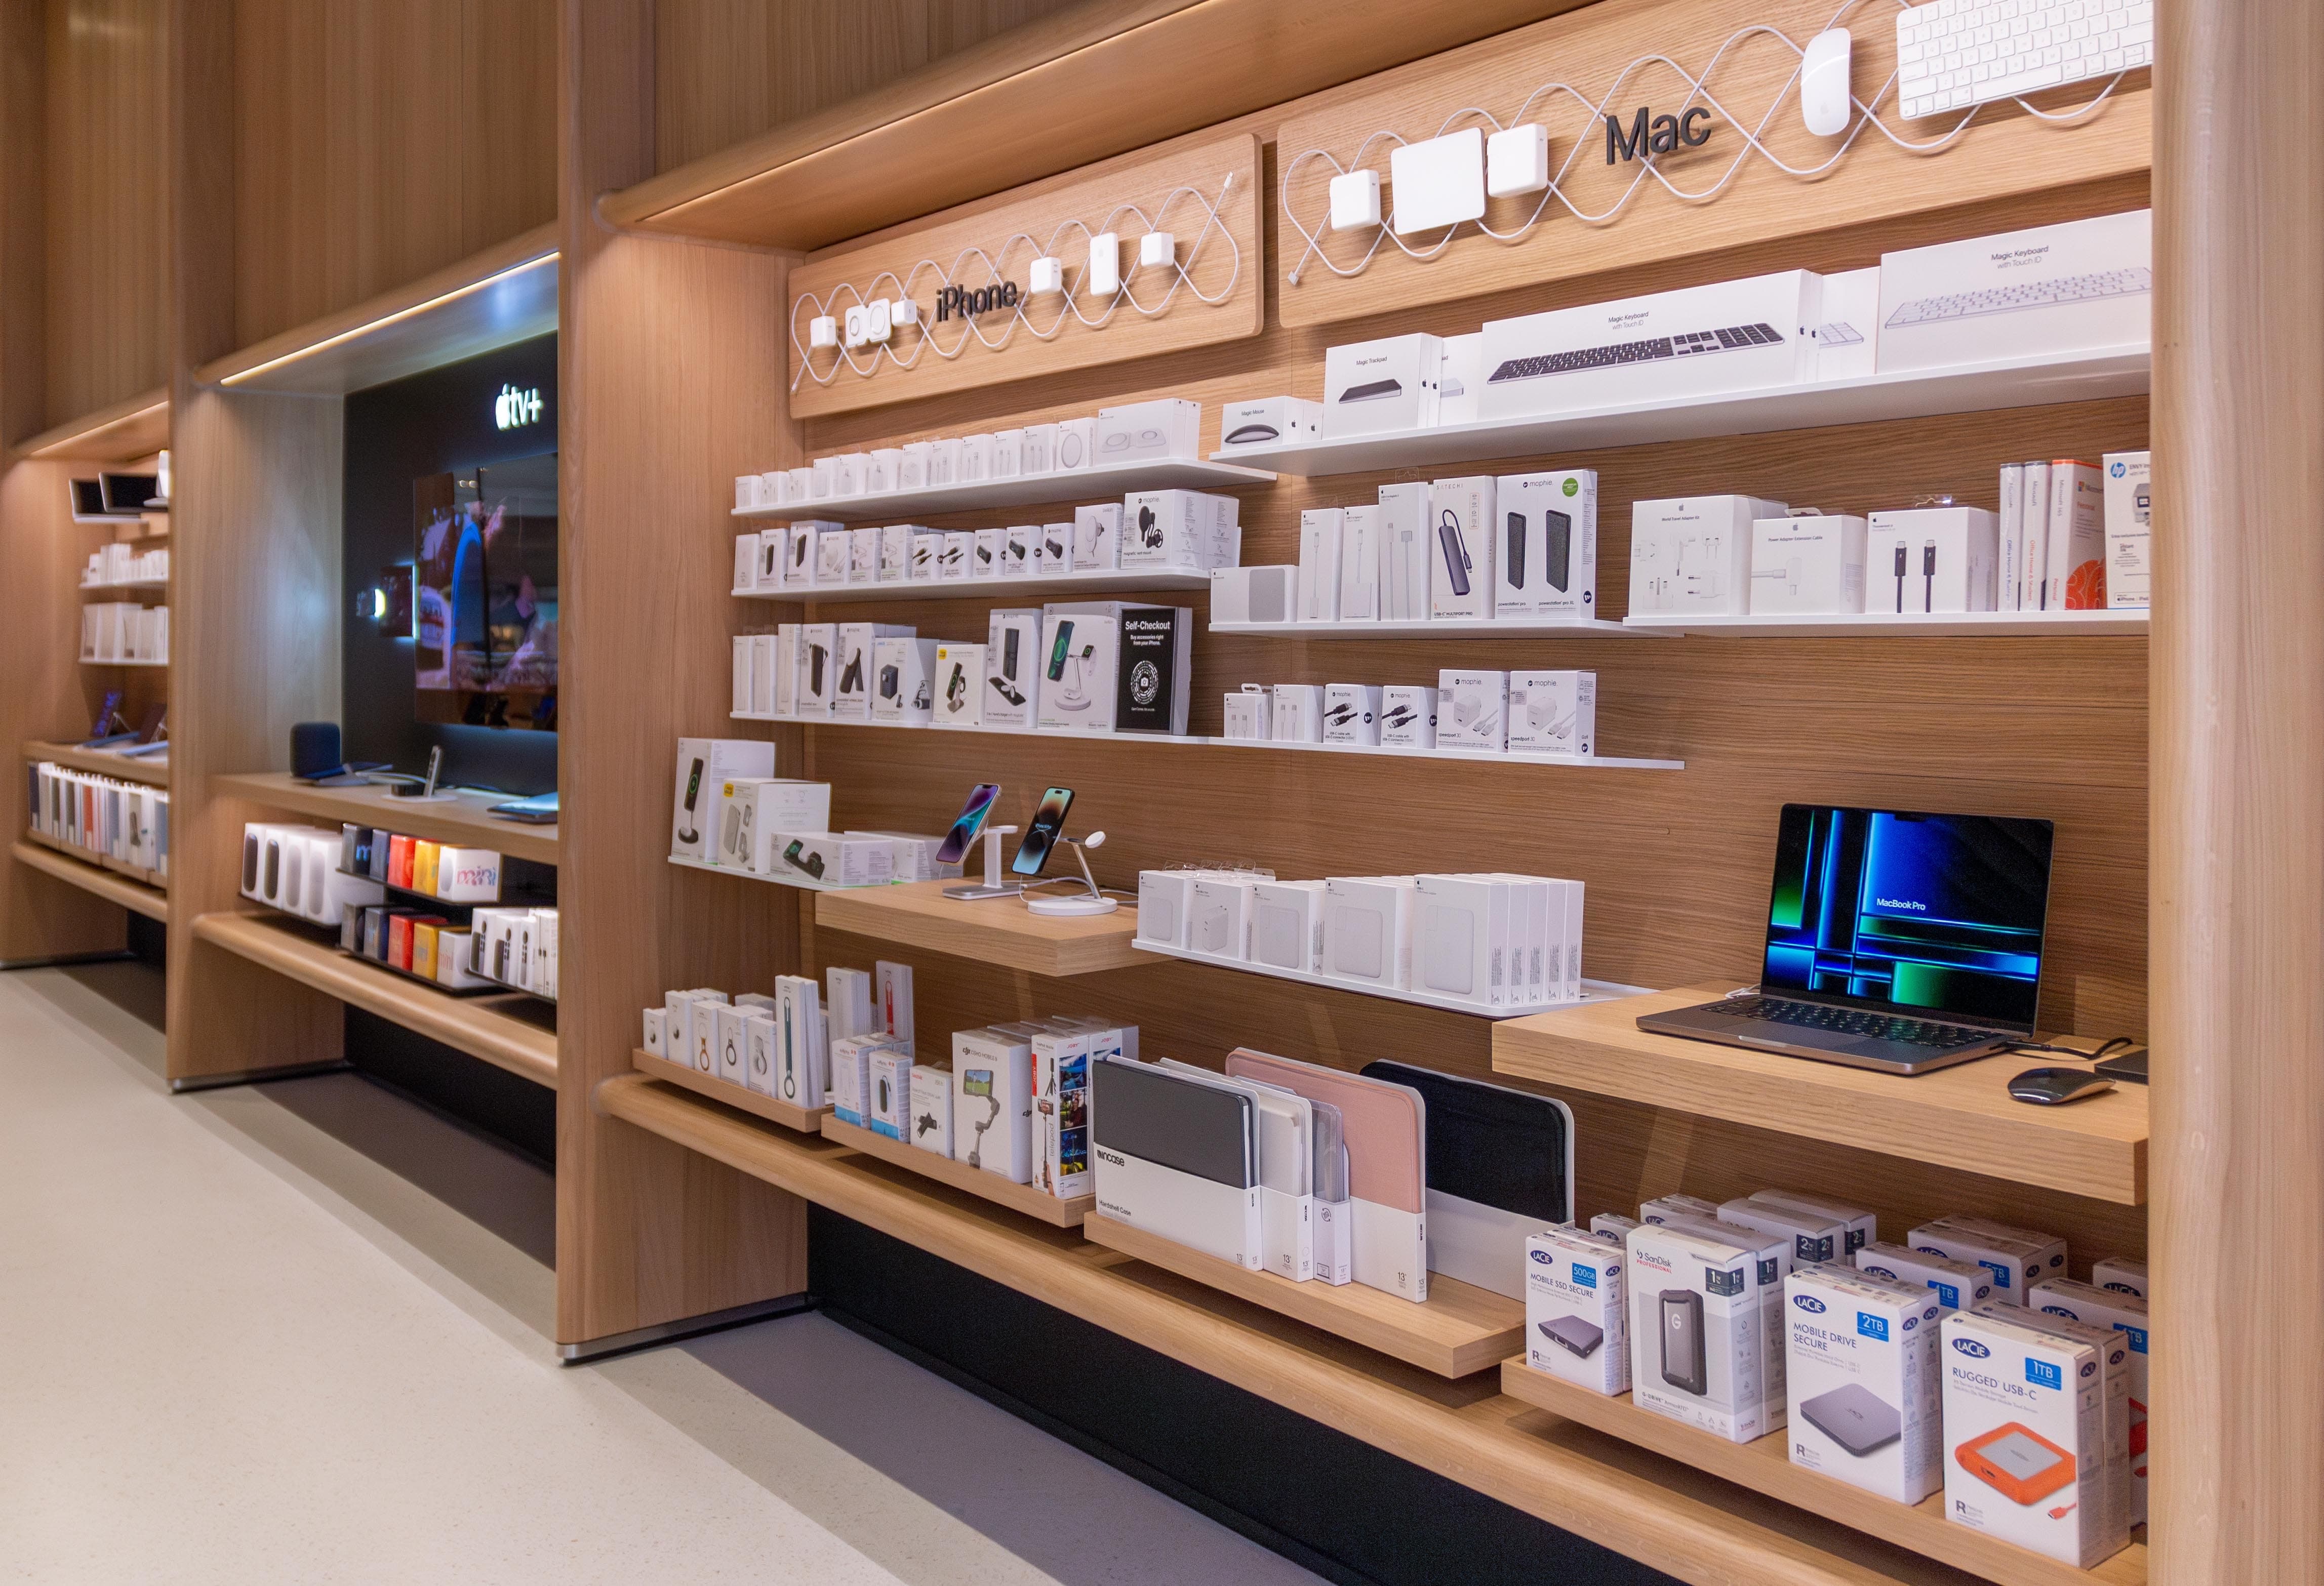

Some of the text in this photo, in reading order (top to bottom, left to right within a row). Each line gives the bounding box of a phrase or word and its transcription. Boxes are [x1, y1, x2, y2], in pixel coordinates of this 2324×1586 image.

[1607, 107, 1711, 165] Mac
[2015, 245, 2049, 257] Keyboard
[2013, 258, 2033, 266] Touch
[936, 281, 1017, 321] iPhone
[1624, 311, 1649, 320] Keyboard
[1369, 356, 1387, 364] Trackpad
[1125, 621, 1171, 630] Self-Checkout
[457, 866, 497, 886] mini
[1876, 898, 1926, 911] MacBook Pro
[1101, 1151, 1125, 1166] incase
[1099, 1199, 1119, 1212] Hardshell
[1119, 1207, 1132, 1216] Case
[1636, 1259, 1672, 1274] PROFESSIONAL
[1645, 1253, 1671, 1268] SanDisk
[1574, 1267, 1595, 1280] 500GB
[1531, 1273, 1553, 1286] MOBILE
[1555, 1280, 1567, 1290] SSD
[1569, 1284, 1594, 1299] SECURE
[1862, 1315, 1885, 1332] 2TB
[1793, 1321, 1857, 1349] MOBILE DRIVE
[1794, 1333, 1828, 1352] SECURE
[2033, 1361, 2054, 1379] 1TB
[1953, 1367, 1998, 1388] RUGGED
[2003, 1382, 2037, 1401] USB-C
